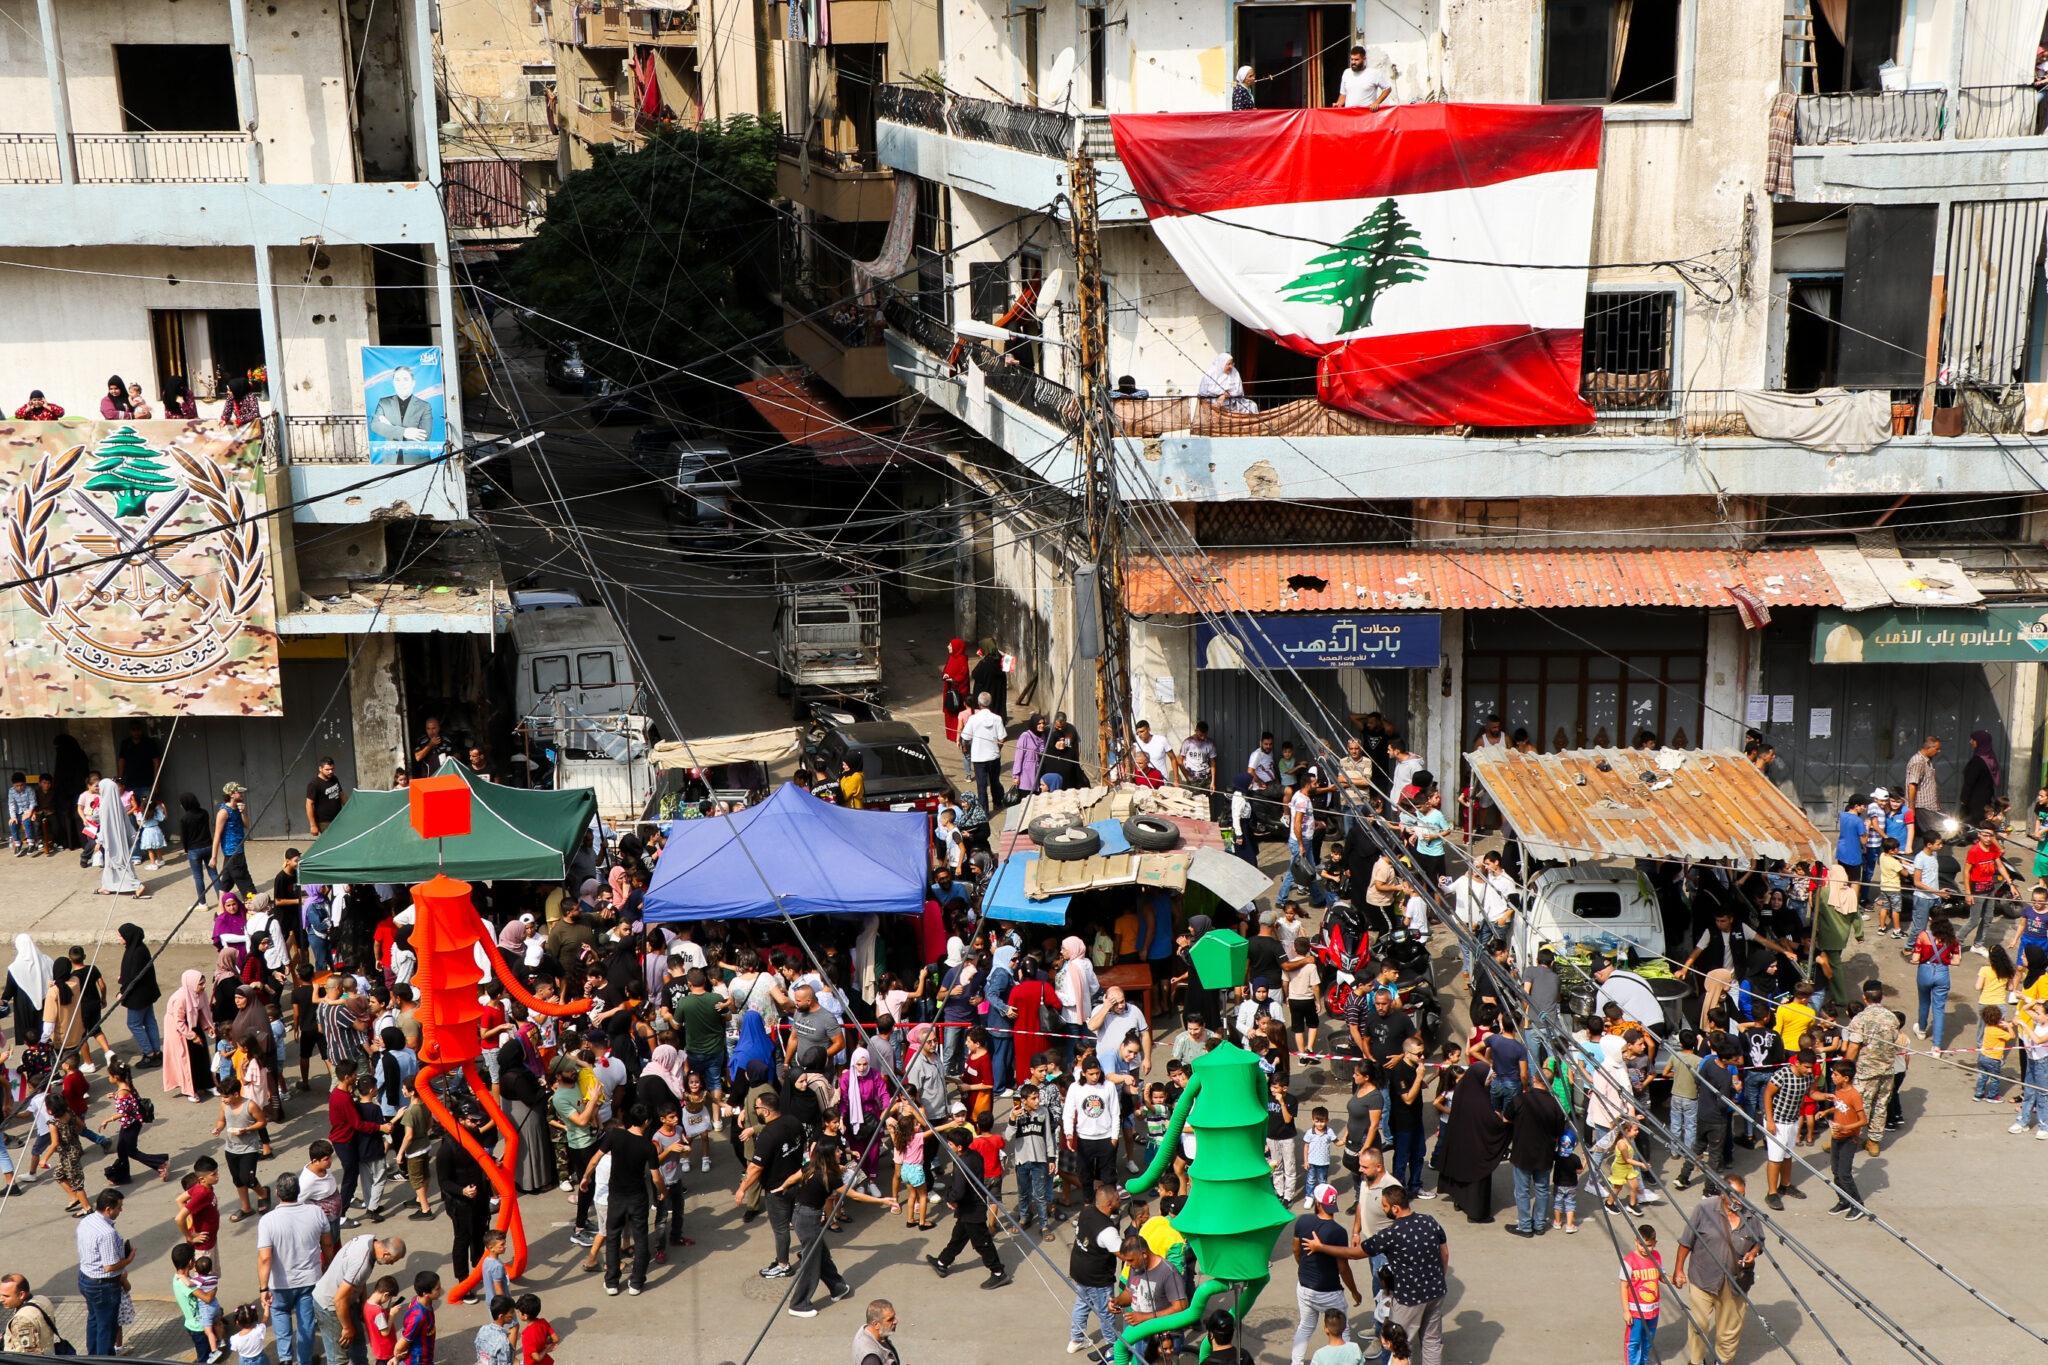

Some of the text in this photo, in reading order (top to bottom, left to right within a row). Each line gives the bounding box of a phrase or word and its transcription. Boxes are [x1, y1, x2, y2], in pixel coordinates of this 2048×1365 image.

[1360, 624, 1401, 634] محلات
[1875, 629, 1922, 647] الذهب
[1926, 628, 1955, 647] باب
[1960, 628, 2012, 647] بلياردو
[1282, 624, 1401, 659] باب الذهب
[73, 639, 218, 675] شرف تضحية وفاء
